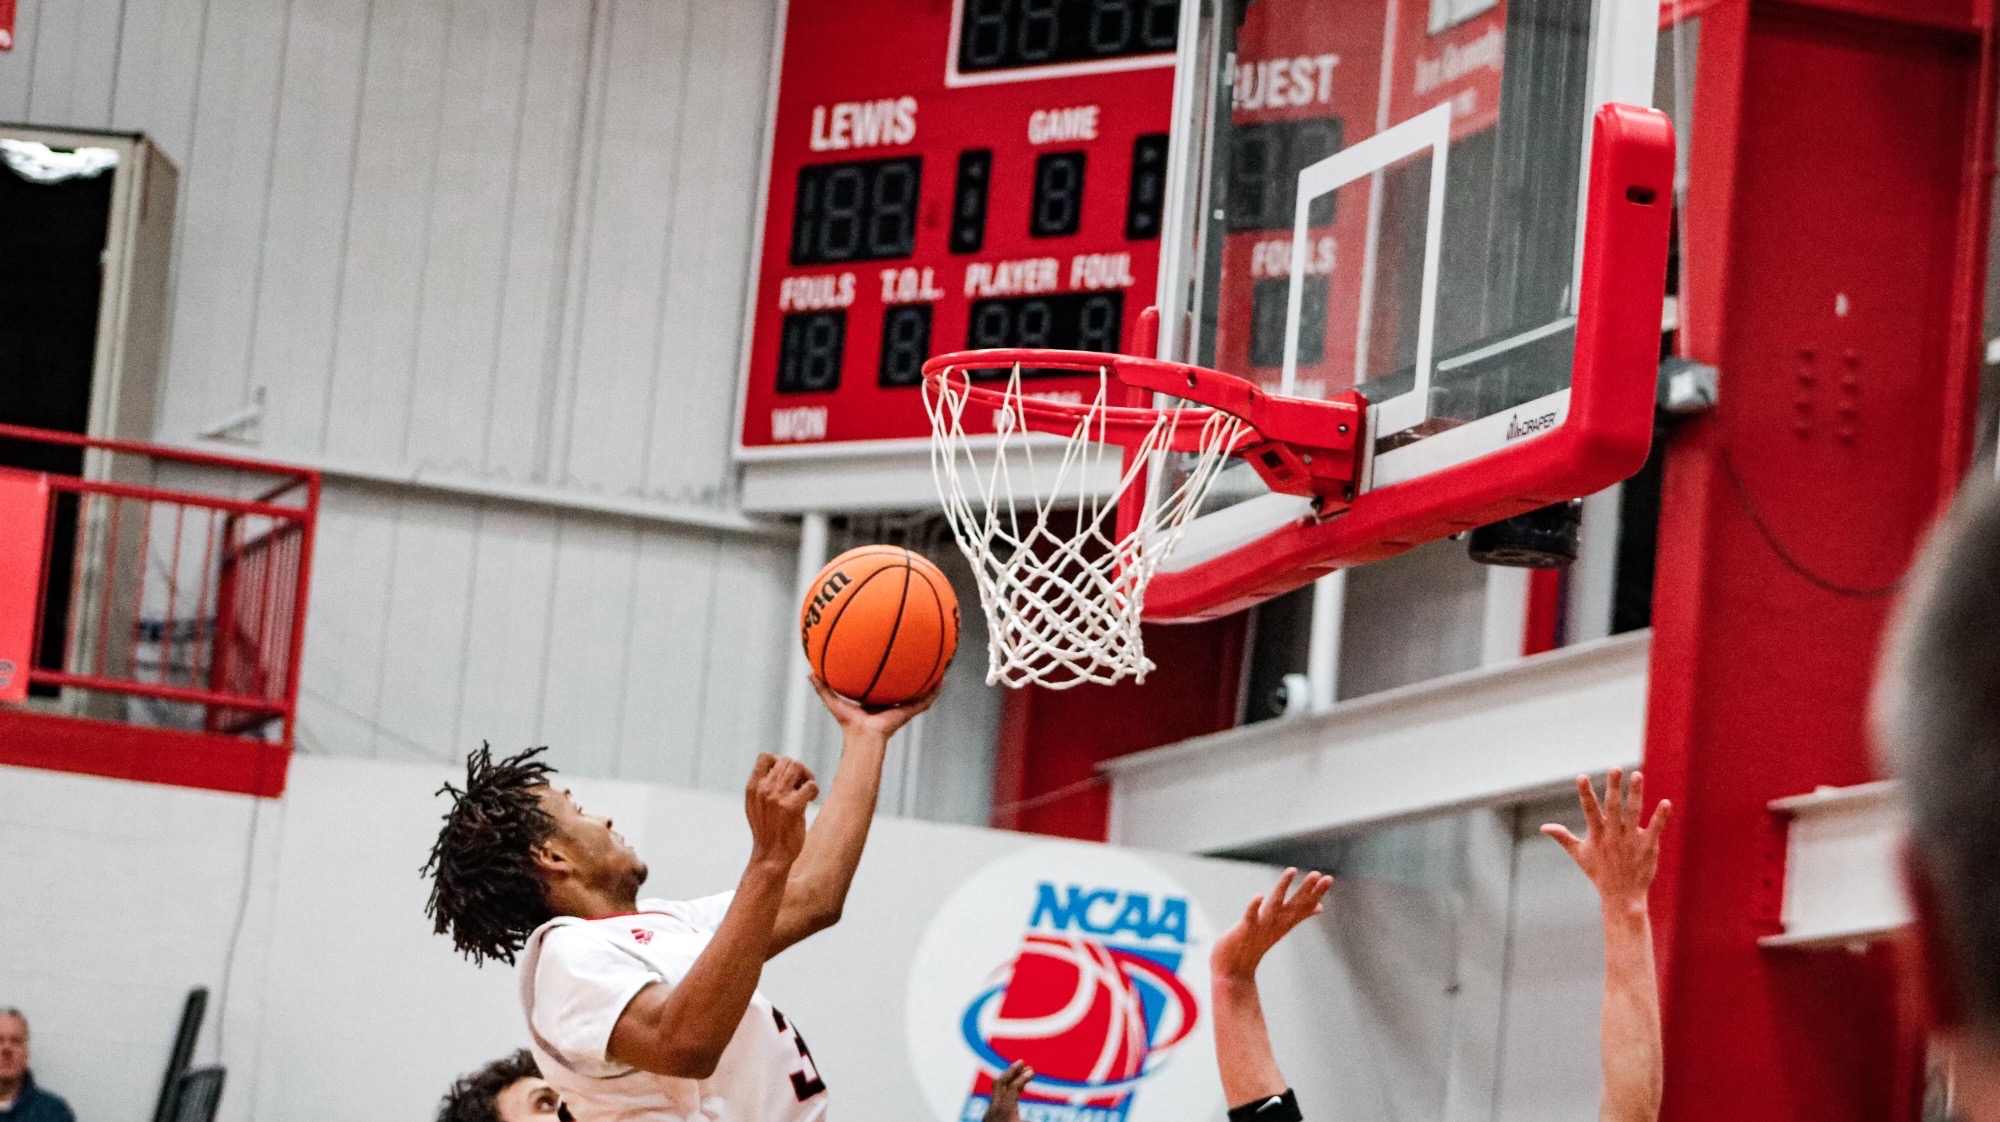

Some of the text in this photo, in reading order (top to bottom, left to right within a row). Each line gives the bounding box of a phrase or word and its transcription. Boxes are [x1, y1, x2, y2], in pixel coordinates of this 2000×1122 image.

[809, 96, 918, 152] LEWIS
[1028, 105, 1100, 145] GAME
[779, 272, 857, 312] FOULS
[880, 266, 946, 304] T.O.L.
[963, 253, 1134, 297] PLAYER FOUL
[771, 406, 829, 441] WON
[1521, 411, 1557, 437] DRAPER
[1028, 882, 1189, 944] NCAA
